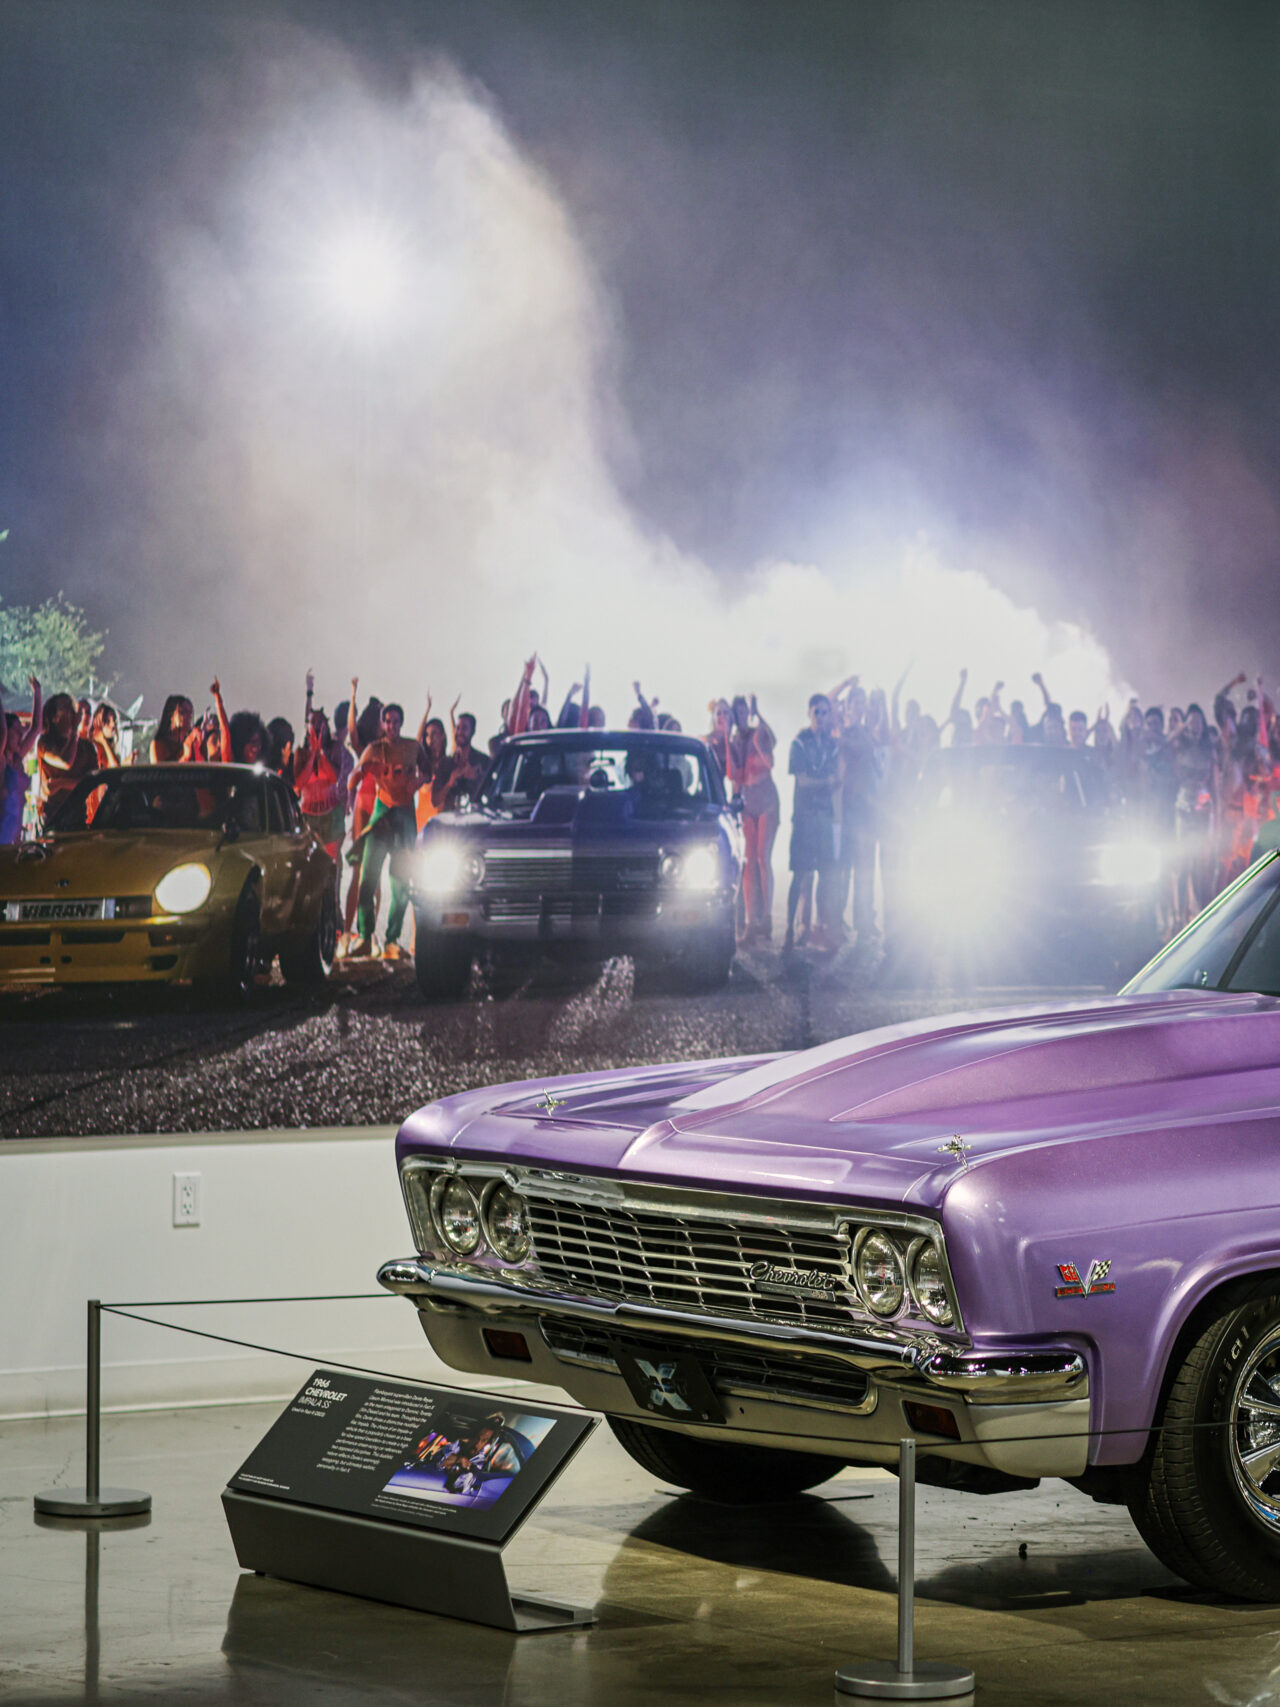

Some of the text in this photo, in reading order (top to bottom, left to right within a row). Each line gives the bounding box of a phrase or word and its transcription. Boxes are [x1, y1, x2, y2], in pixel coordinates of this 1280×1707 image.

[22, 903, 99, 919] VIBRANT
[749, 1260, 837, 1291] Chevrolet
[313, 1378, 331, 1388] 1966
[305, 1387, 348, 1401] CHEVROLET
[321, 1400, 332, 1409] SS
